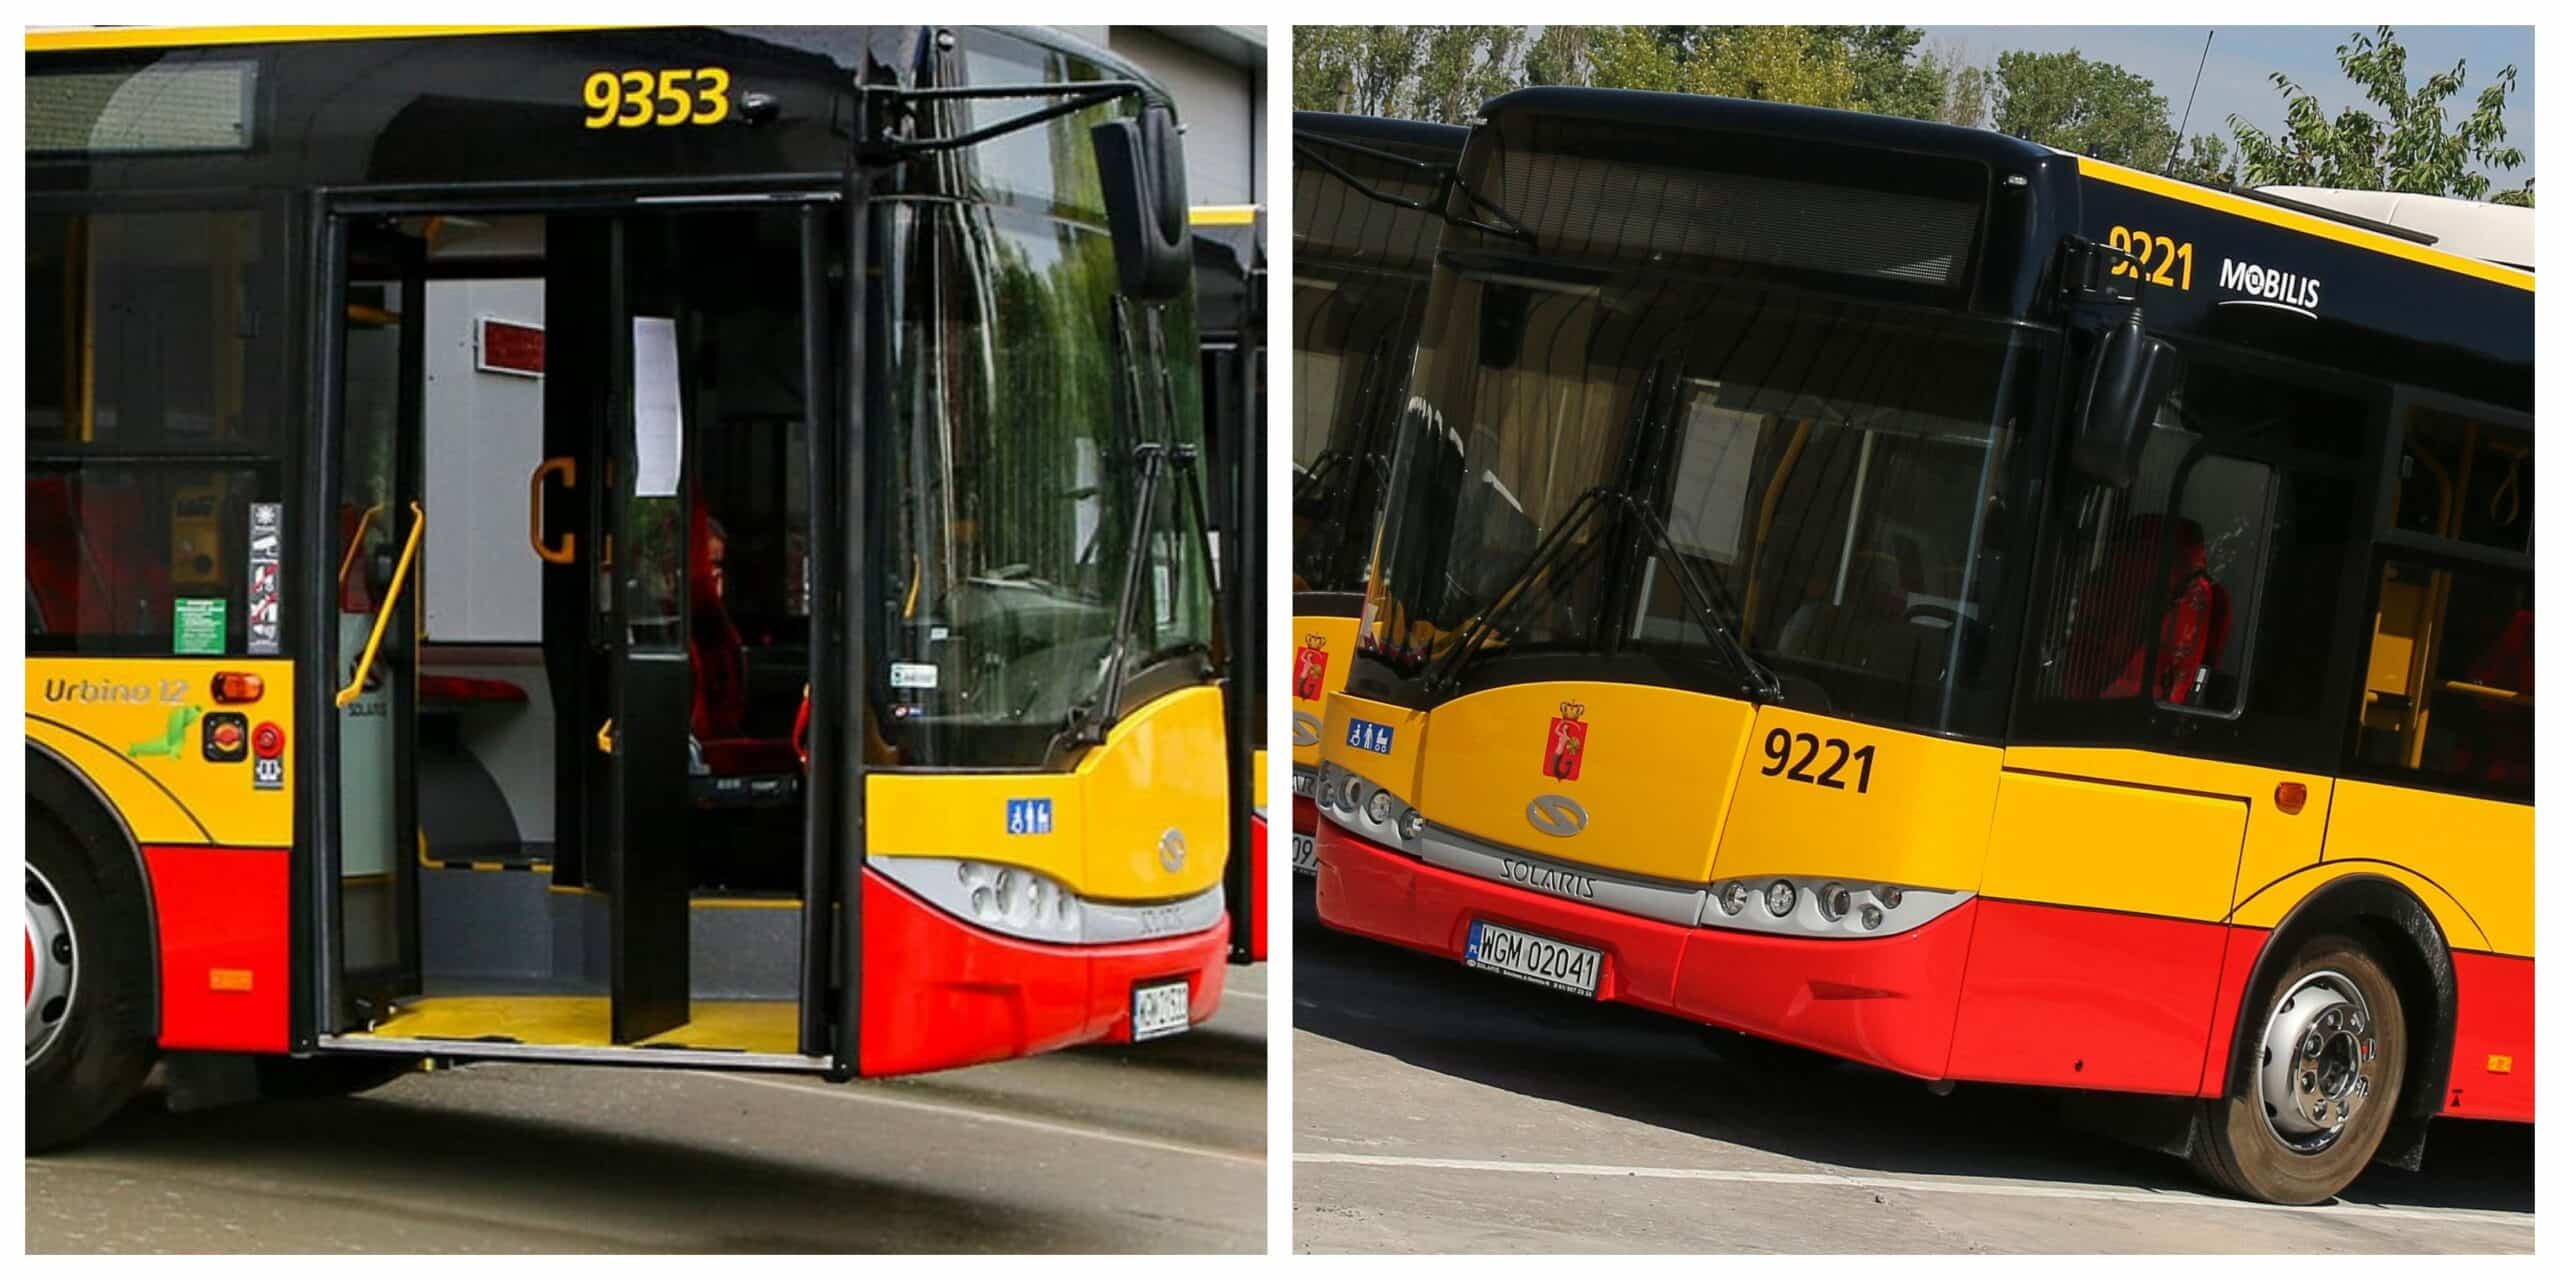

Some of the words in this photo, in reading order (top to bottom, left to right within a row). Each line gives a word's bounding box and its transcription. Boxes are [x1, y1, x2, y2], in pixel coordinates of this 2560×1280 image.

[584, 67, 731, 129] 9353
[2109, 226, 2193, 291] 9221
[2219, 257, 2320, 308] MOBILIS
[45, 678, 150, 702] Urbino
[159, 679, 188, 703] 12
[1761, 727, 1876, 794] 9221
[1500, 858, 1596, 898] SOLARIS
[1481, 927, 1523, 968] WGM
[1528, 941, 1595, 986] 02041
